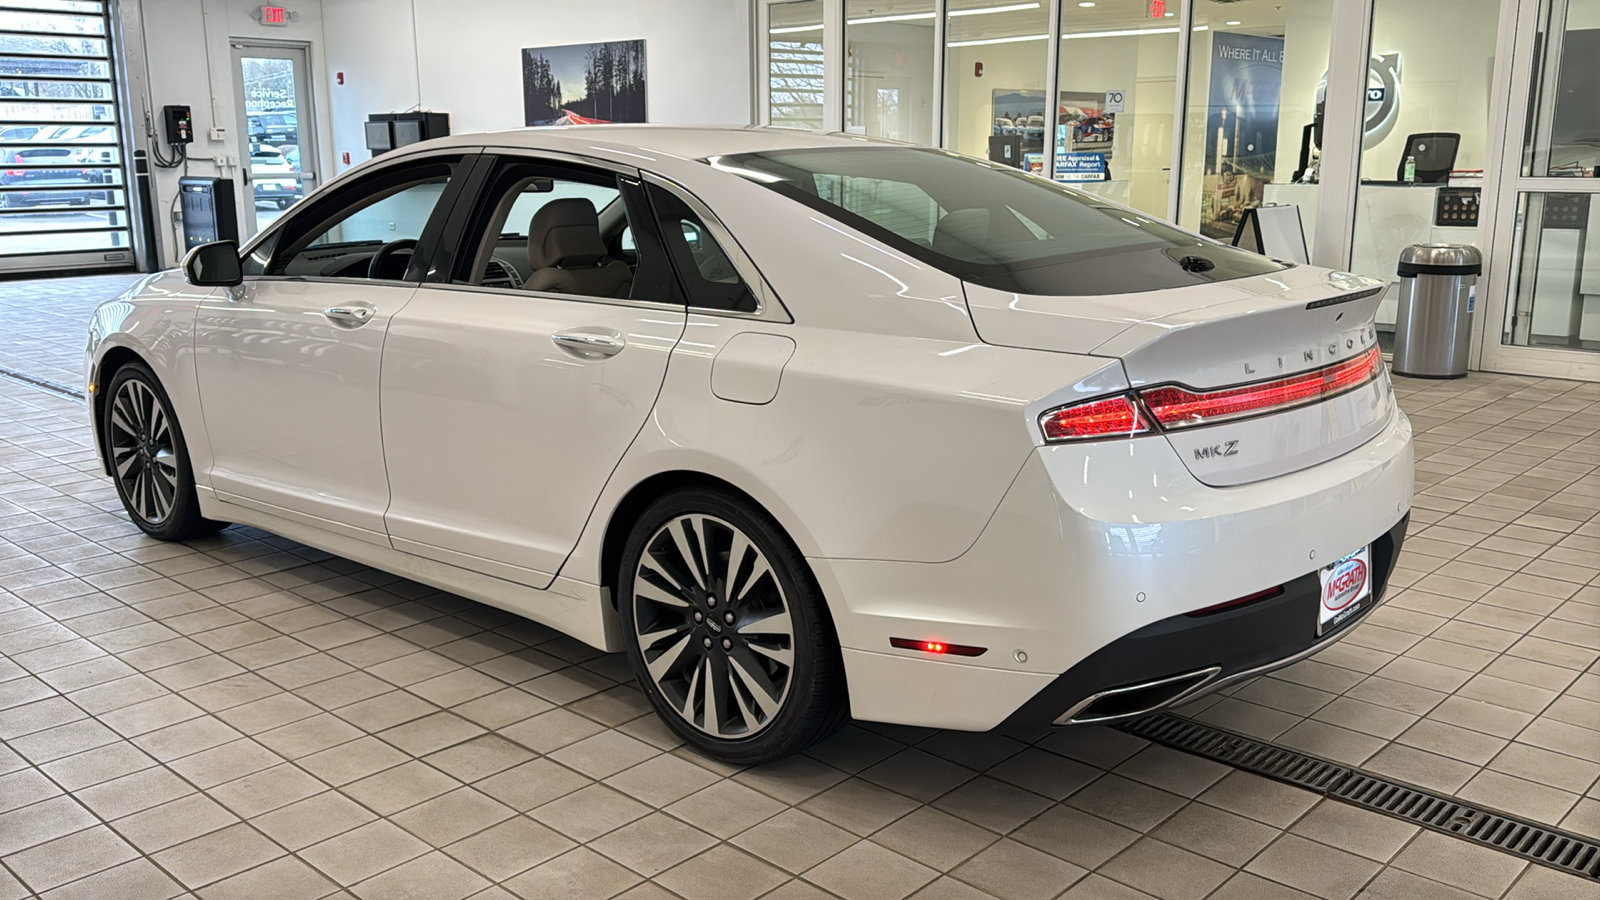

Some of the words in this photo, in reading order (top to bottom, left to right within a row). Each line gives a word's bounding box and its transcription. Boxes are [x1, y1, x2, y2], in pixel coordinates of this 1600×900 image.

[266, 6, 284, 22] EXIT
[1108, 92, 1123, 104] 70
[1079, 161, 1101, 169] Report
[1193, 439, 1239, 460] MKZ
